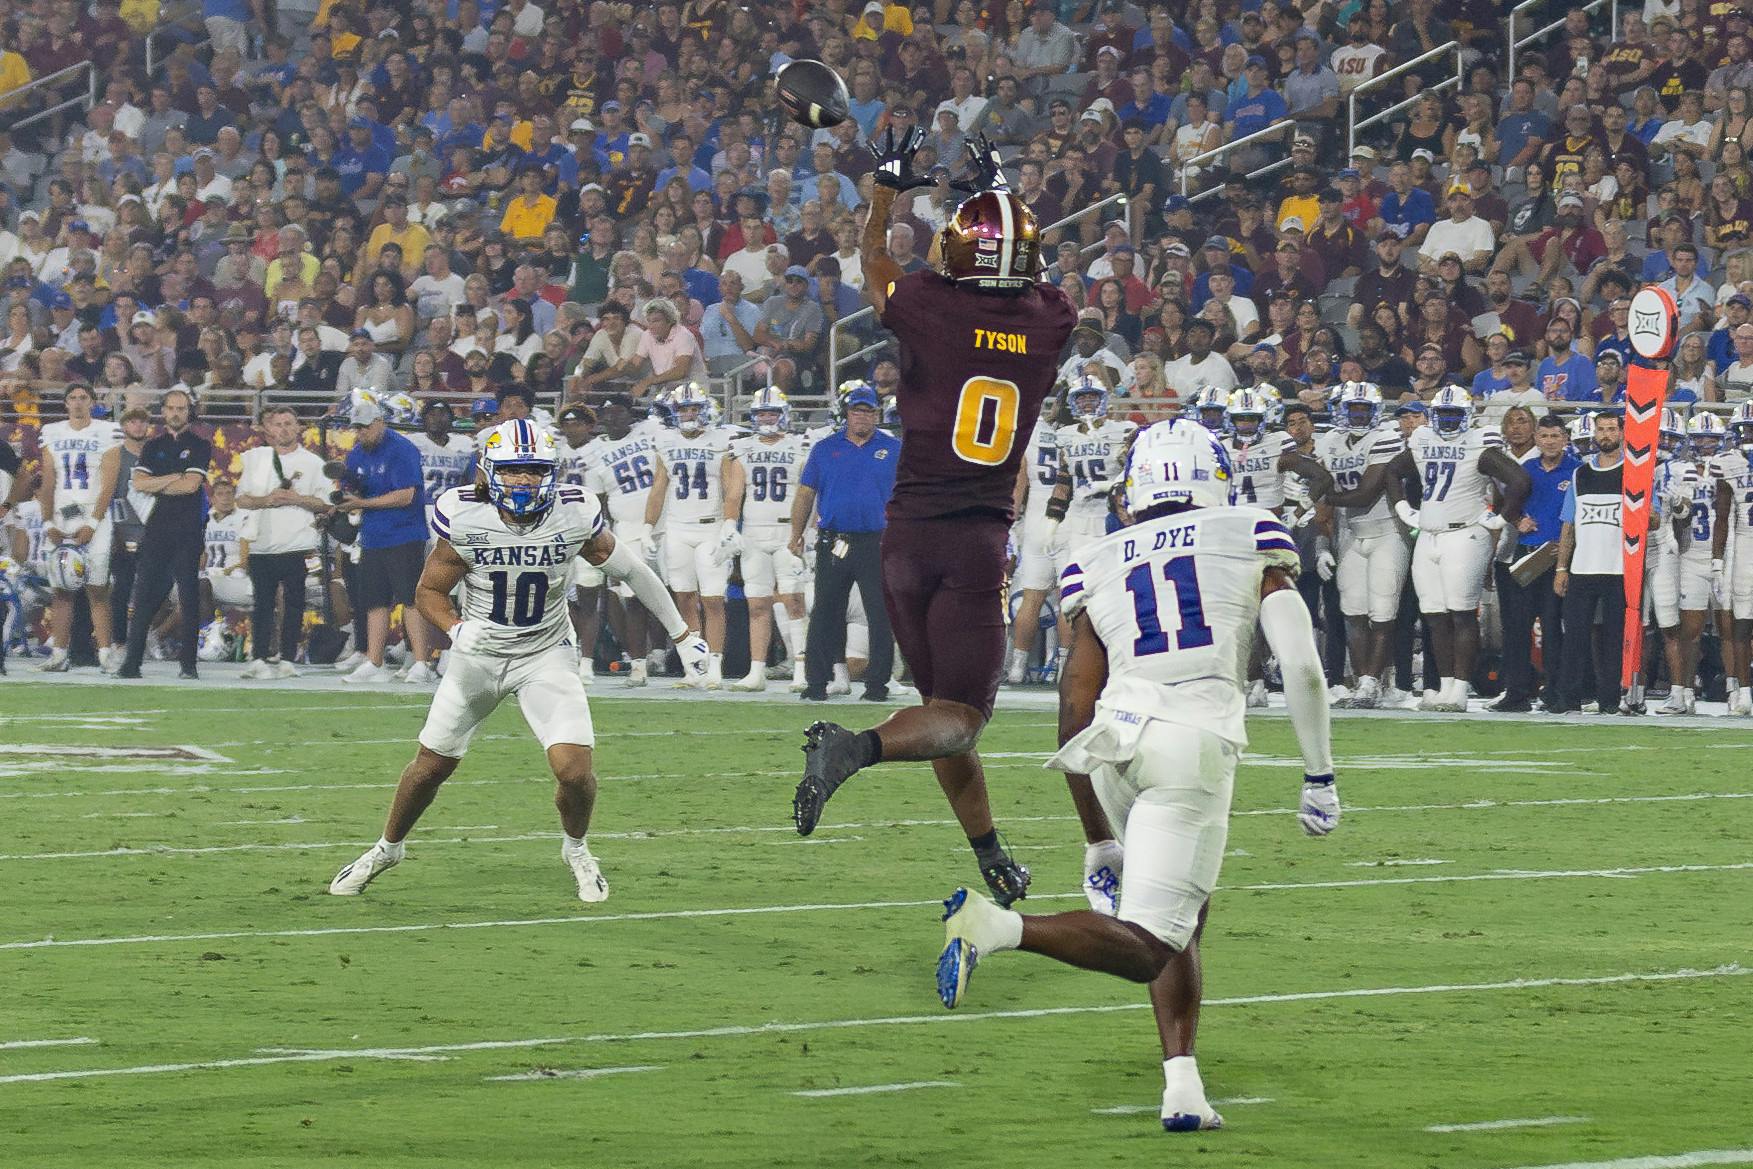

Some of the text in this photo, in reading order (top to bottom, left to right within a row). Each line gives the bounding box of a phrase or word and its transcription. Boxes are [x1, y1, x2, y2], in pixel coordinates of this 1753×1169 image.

[1337, 57, 1368, 75] ASU
[974, 329, 1027, 354] TYSON
[952, 375, 1020, 466] 0
[602, 438, 650, 467] KANSAS
[668, 449, 714, 461] KANSAS
[747, 451, 795, 464] KANSAS
[1421, 446, 1466, 460] KANSAS
[63, 453, 89, 490] 14
[612, 455, 655, 495] 56
[672, 462, 708, 500] 34
[751, 466, 788, 502] 96
[1164, 461, 1179, 481] 11
[1423, 462, 1456, 502] 97
[473, 545, 568, 567] KANSAS
[1123, 525, 1196, 562] D. DYE
[488, 570, 549, 627] 10
[1125, 554, 1215, 657] 11
